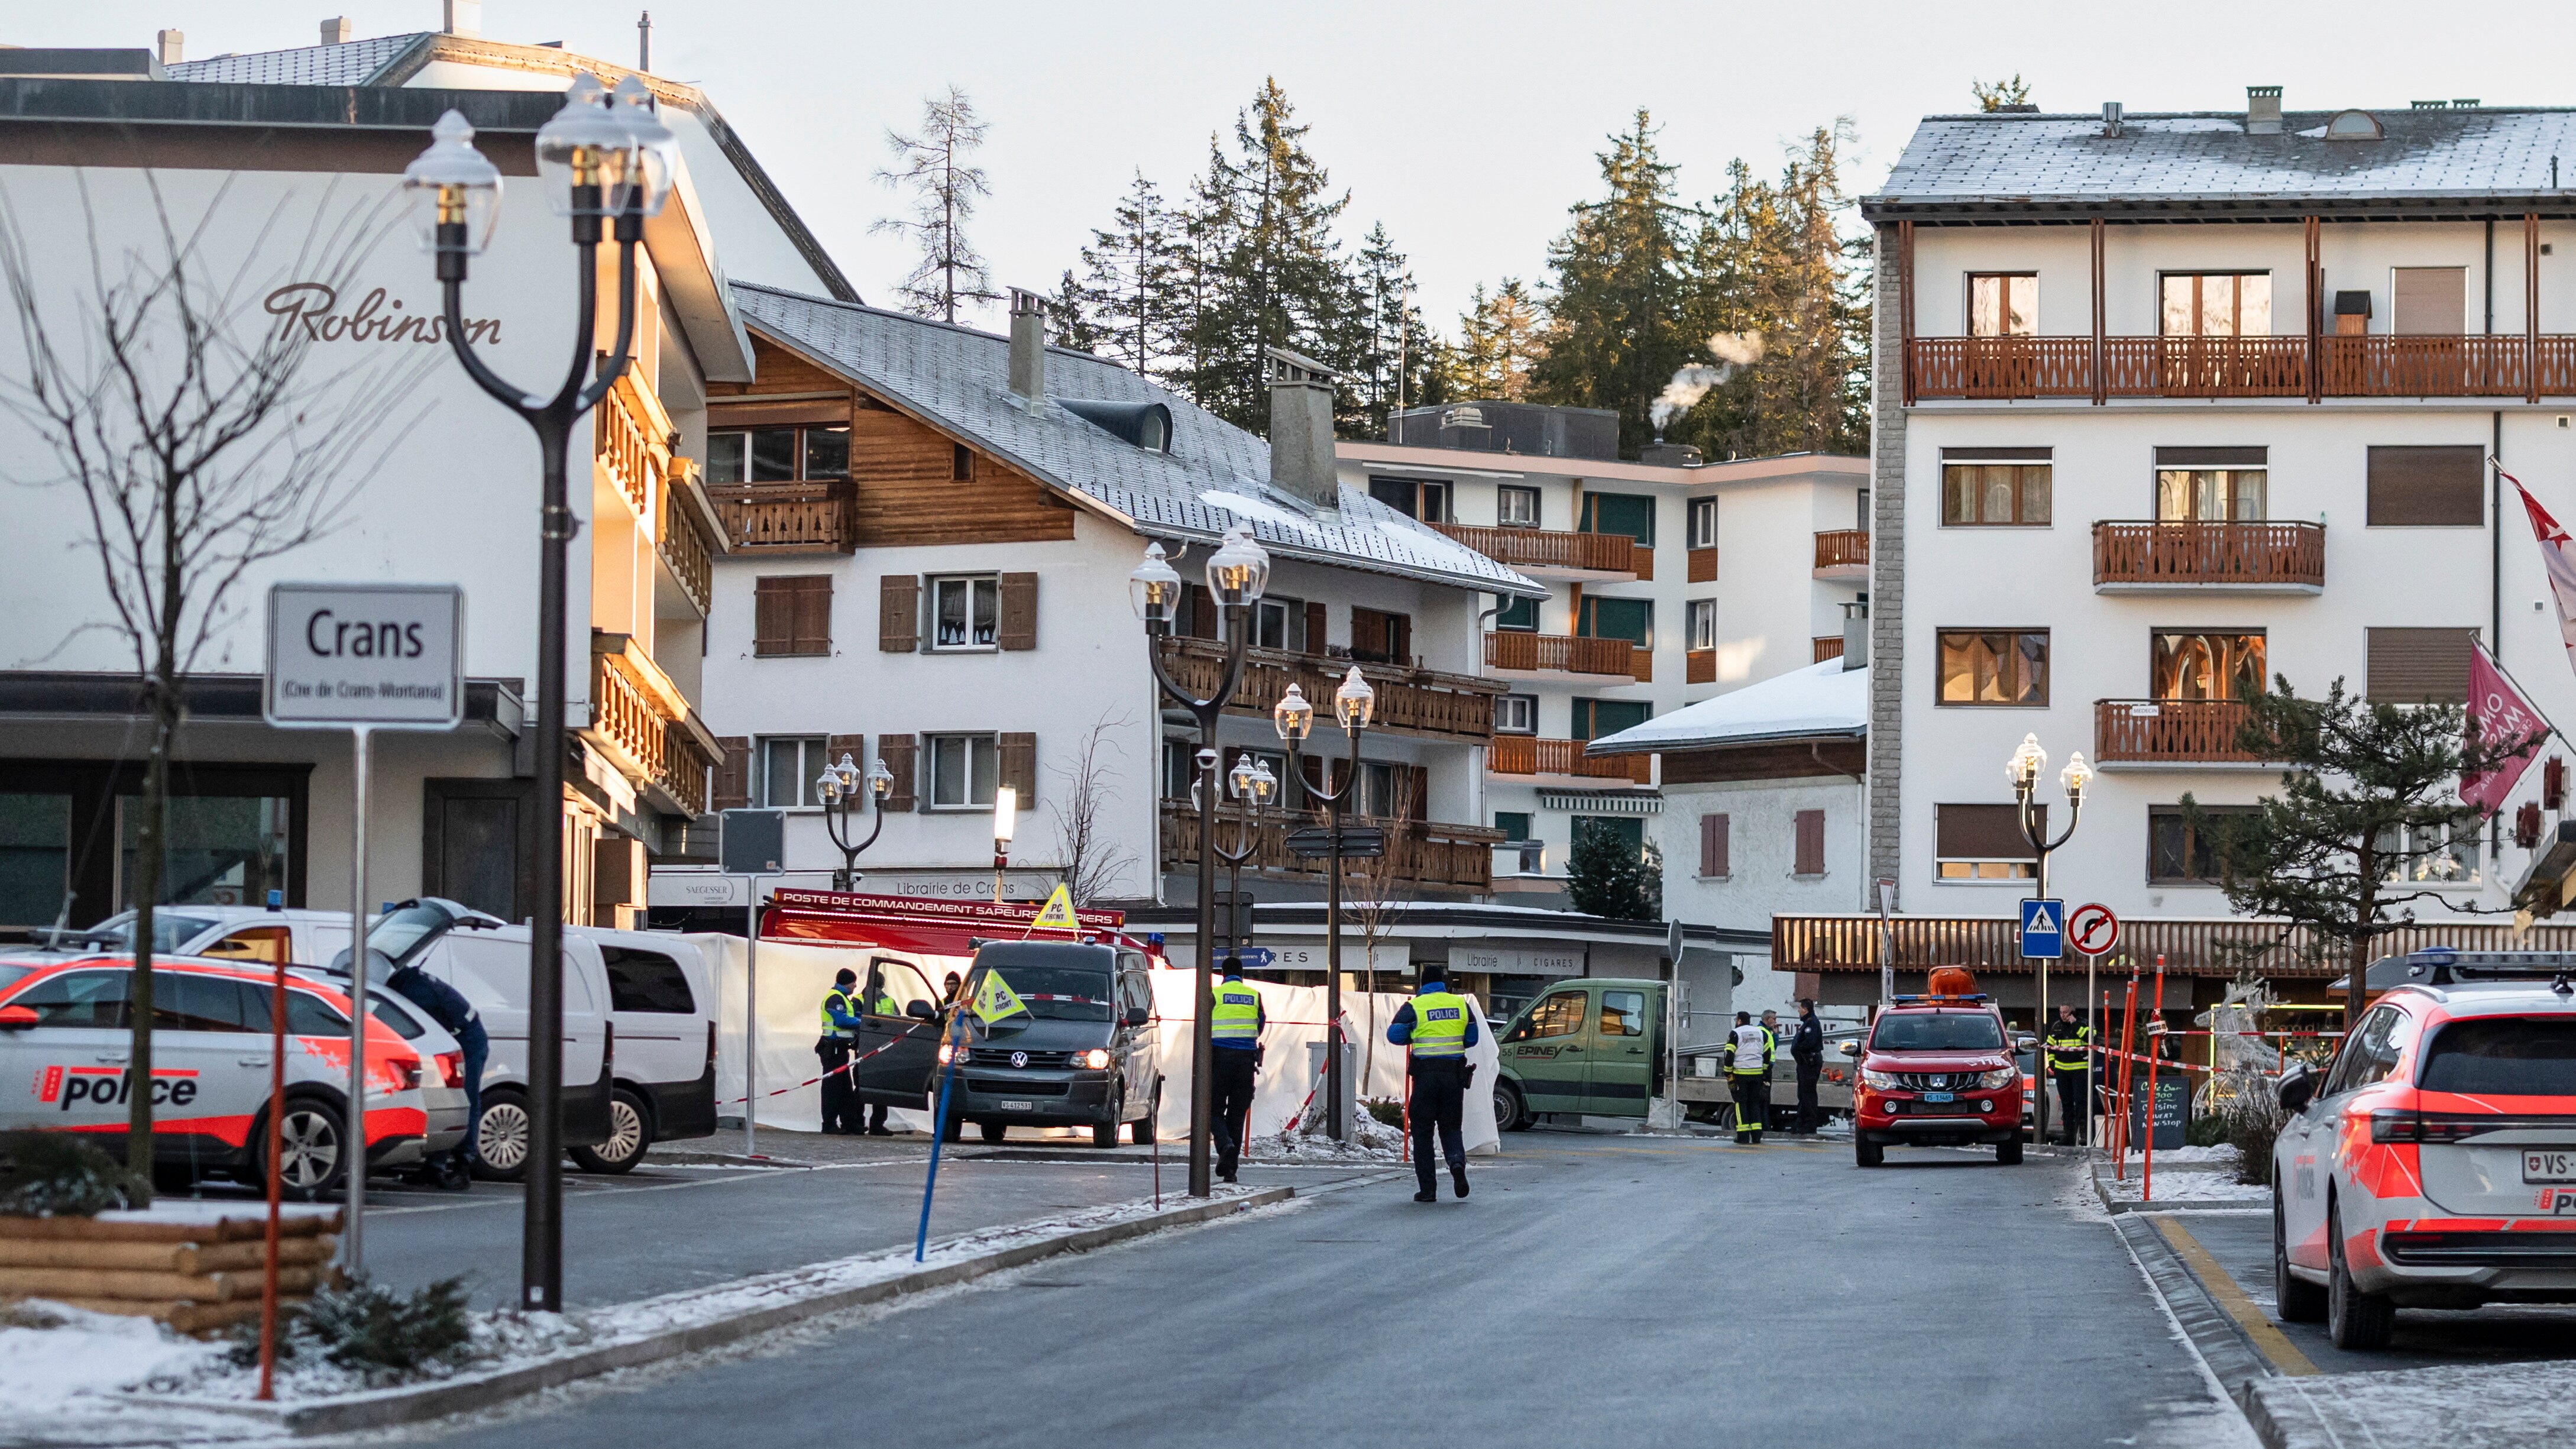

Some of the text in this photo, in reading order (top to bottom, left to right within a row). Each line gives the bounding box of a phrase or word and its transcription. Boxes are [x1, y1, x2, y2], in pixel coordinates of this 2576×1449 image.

[307, 608, 423, 657] Crans
[897, 882, 948, 895] Librairie
[953, 882, 970, 894] de
[783, 892, 1112, 924] POSTE DE COMMANDEMENT SAPEURS PIERS
[1051, 904, 1063, 912] PC
[1271, 952, 1308, 962] RES
[1467, 953, 1498, 967] Librairie
[1533, 958, 1573, 968] CIGARES
[995, 991, 1006, 1002] PC
[1225, 994, 1253, 1004] POLICE
[995, 1000, 1012, 1012] FRONT
[1429, 1010, 1458, 1020] POLICE
[1502, 1049, 1513, 1057] 55
[1517, 1046, 1564, 1059] EPINEY
[62, 1068, 197, 1111] polce
[2142, 1103, 2177, 1111] Cisine
